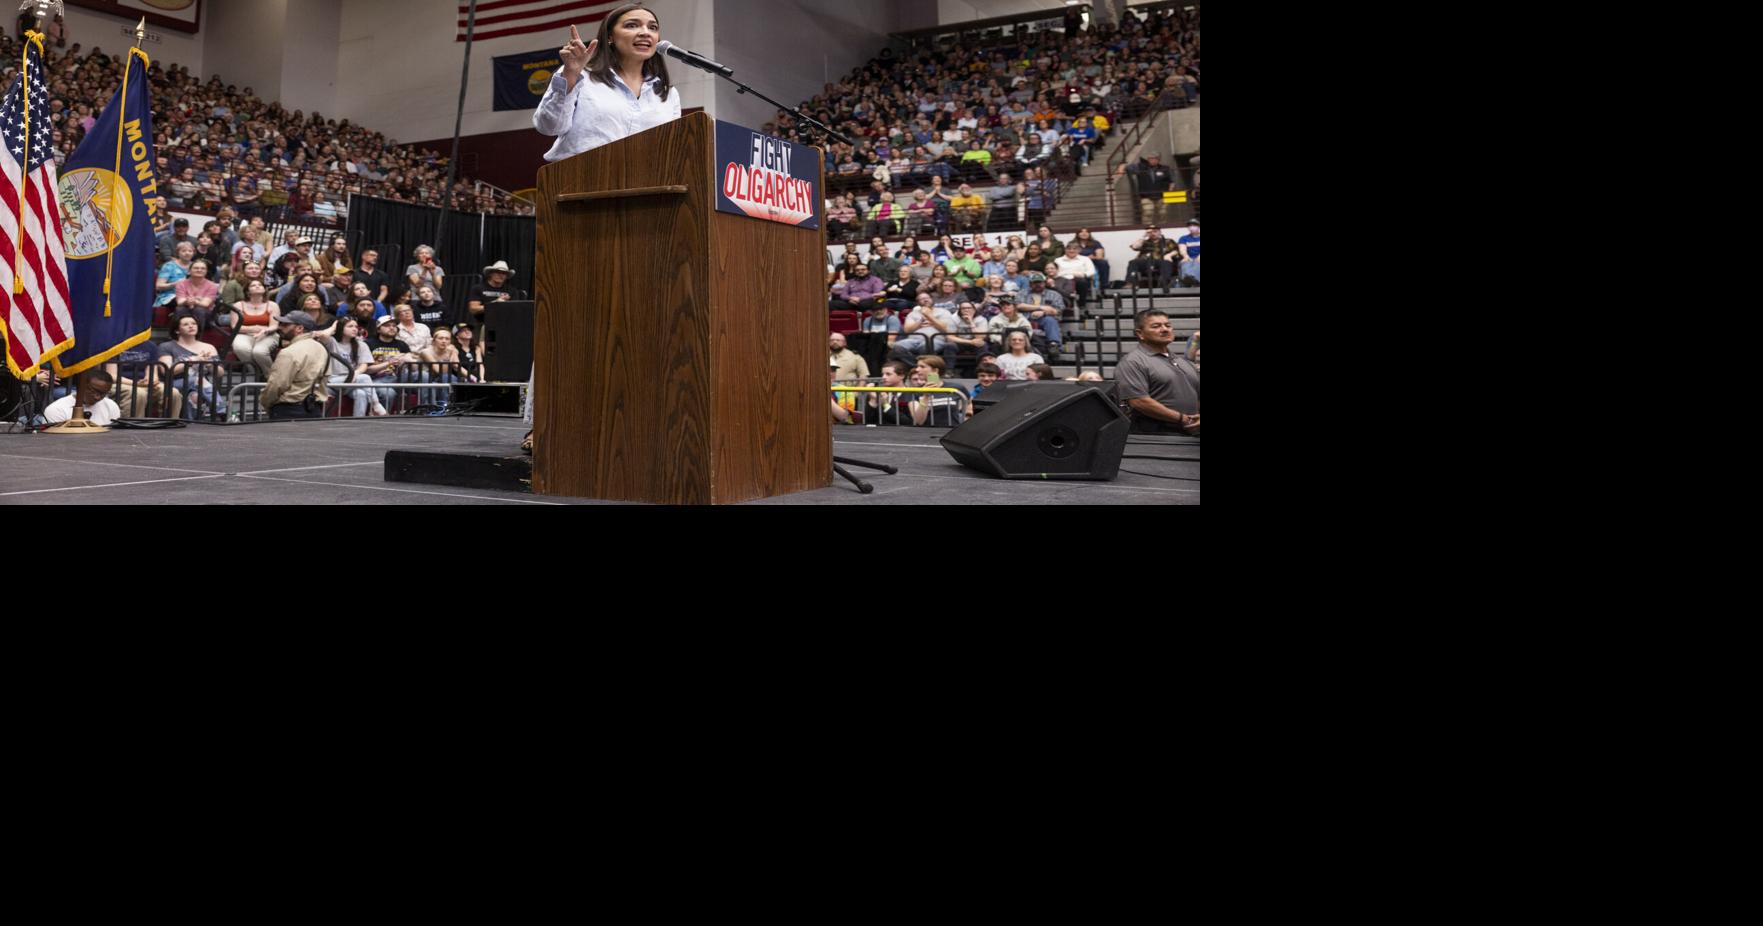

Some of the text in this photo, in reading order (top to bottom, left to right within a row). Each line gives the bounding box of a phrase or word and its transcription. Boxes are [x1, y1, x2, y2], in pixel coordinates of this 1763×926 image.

[124, 118, 157, 225] MONTA
[751, 132, 791, 175] FIGHT
[724, 162, 813, 215] OLIGARCHY
[951, 237, 972, 247] SE
